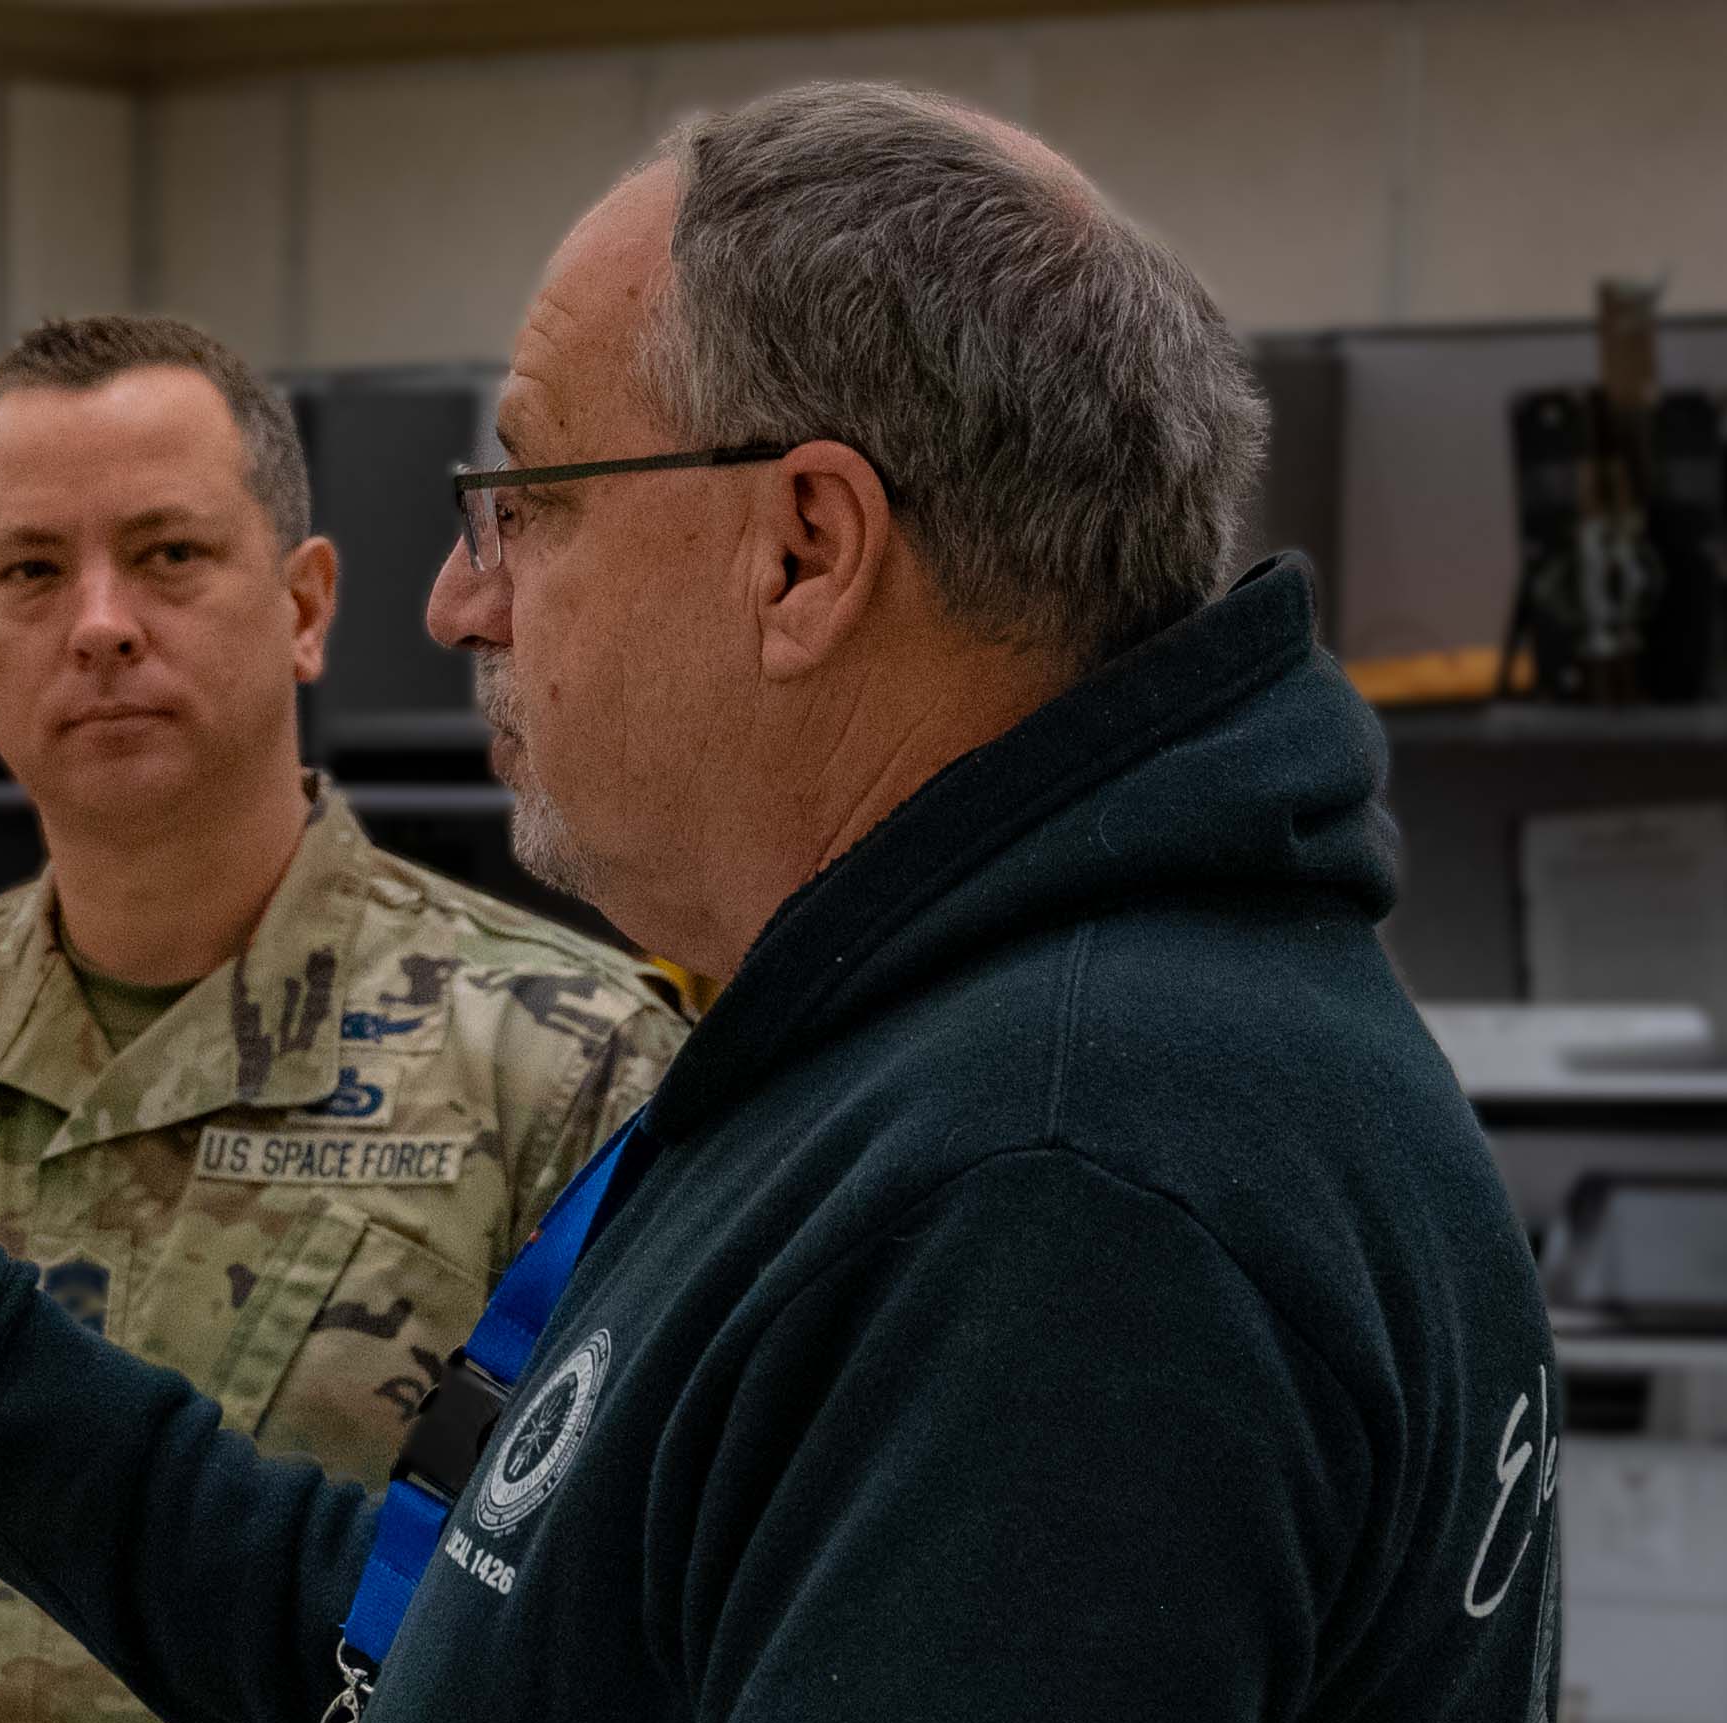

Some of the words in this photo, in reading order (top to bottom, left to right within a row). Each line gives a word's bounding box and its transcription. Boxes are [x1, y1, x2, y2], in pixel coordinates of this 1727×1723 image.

[261, 1138, 358, 1179] SPACE
[359, 1139, 454, 1179] FORCE
[470, 1548, 516, 1594] 1426
